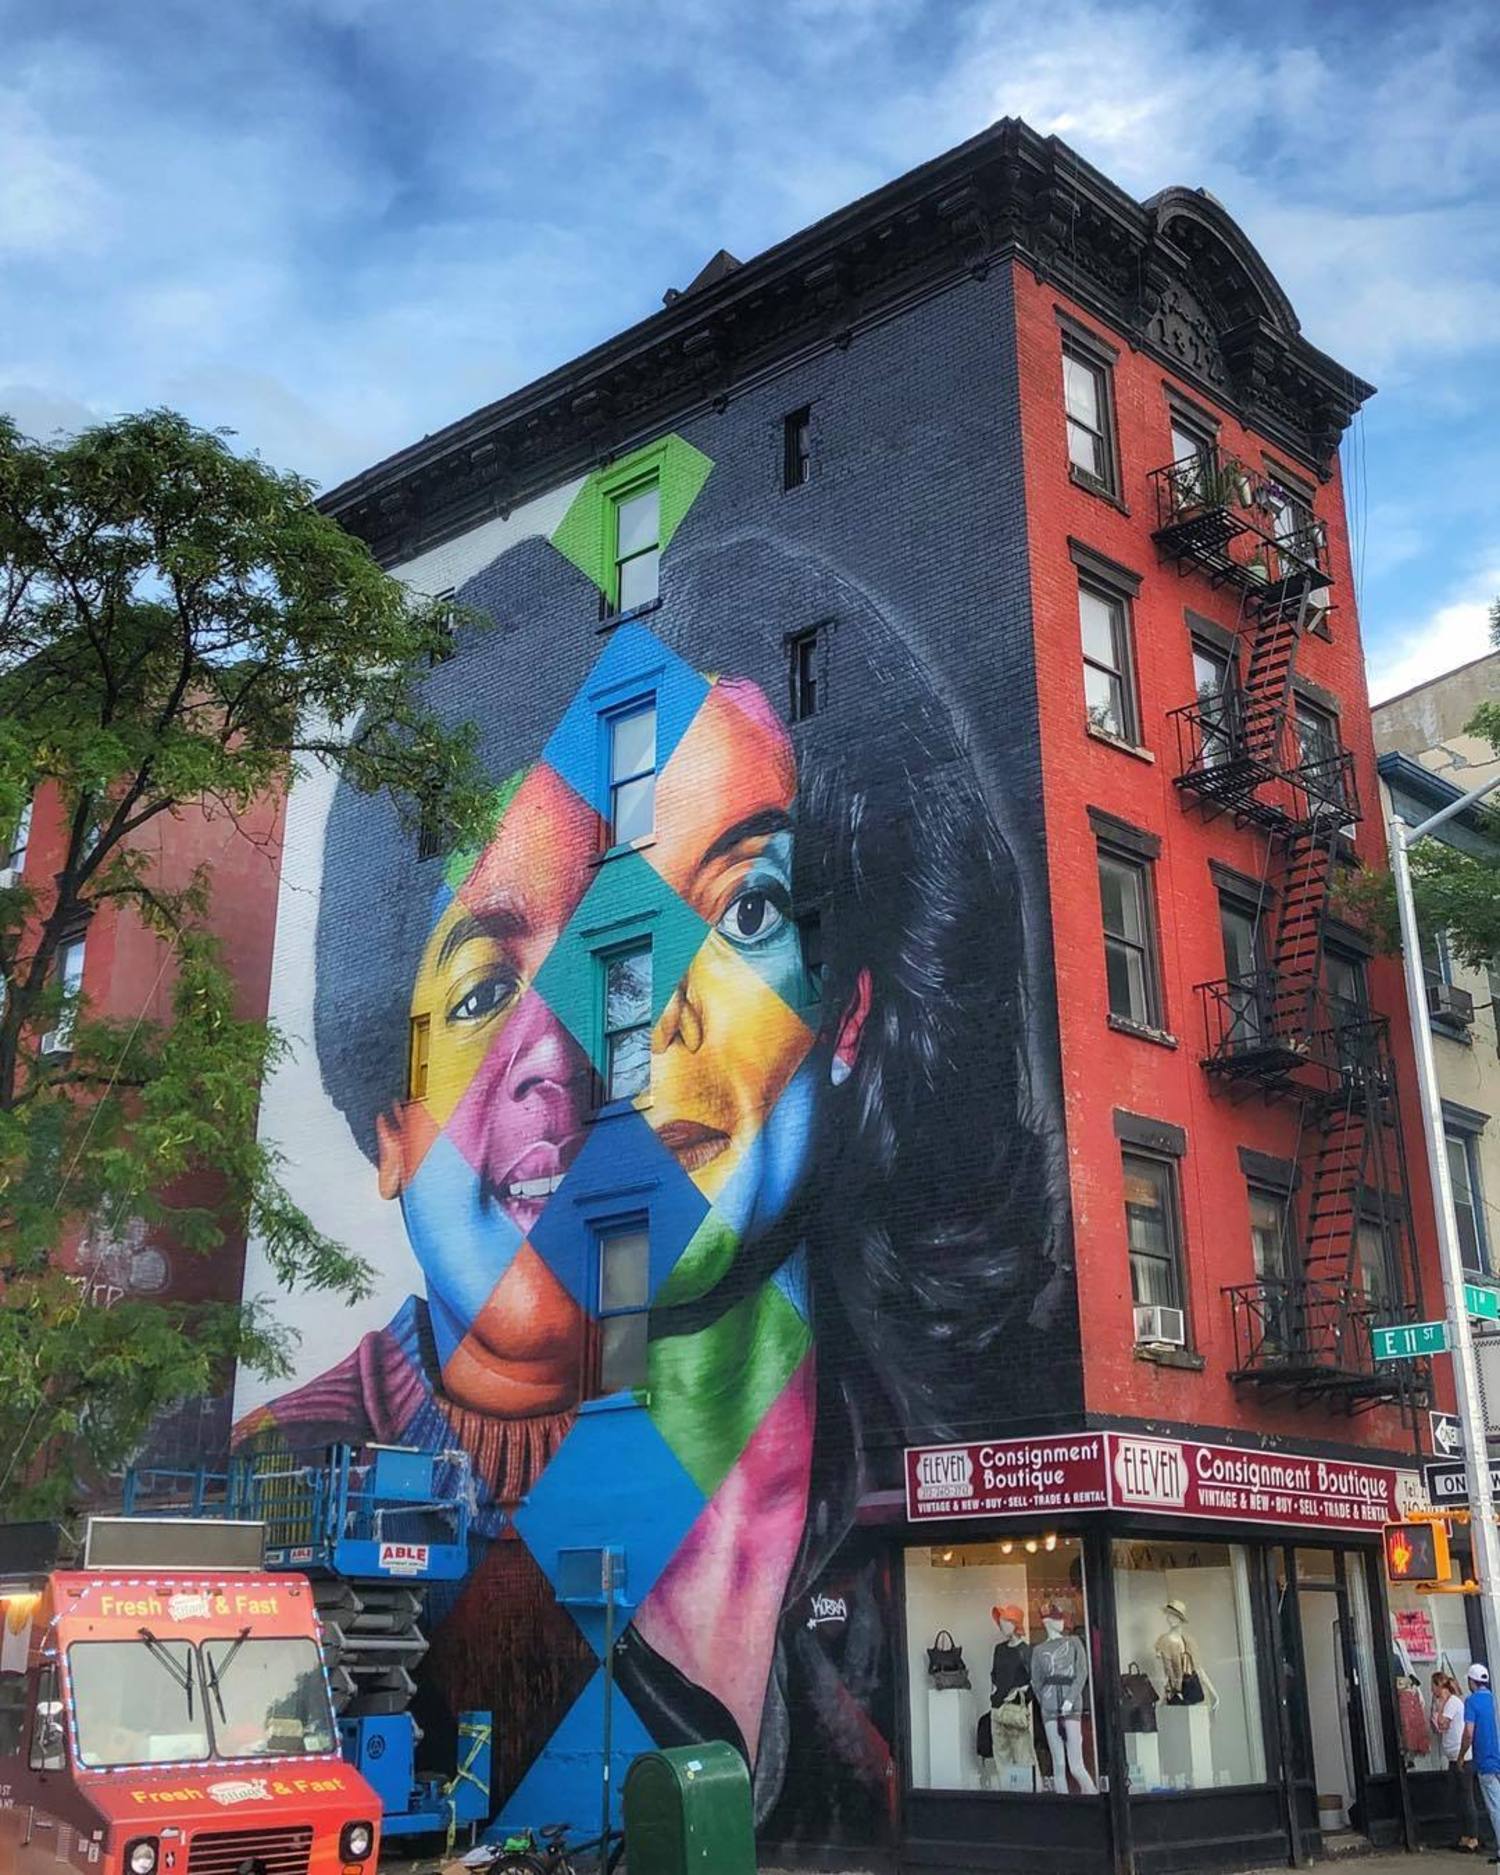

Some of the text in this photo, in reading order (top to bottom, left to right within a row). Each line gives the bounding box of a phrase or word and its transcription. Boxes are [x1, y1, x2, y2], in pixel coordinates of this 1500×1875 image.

[1385, 1327, 1434, 1354] E 11 ST
[979, 1440, 1099, 1469] Consignment
[923, 1455, 965, 1484] ELEVEN
[984, 1469, 1065, 1492] Boutique
[1123, 1446, 1180, 1499] ELEVEN
[1196, 1448, 1388, 1504] Consignment Boutique
[1444, 1475, 1467, 1492] ON
[917, 1490, 1106, 1514] VINTAGE & NEW BUY SELL TRADE & RENTAL
[1198, 1488, 1237, 1508] VINTAGE
[1240, 1491, 1247, 1510] &
[1249, 1492, 1269, 1511] NEW
[1275, 1495, 1293, 1513] BUY
[1299, 1498, 1319, 1516] SELL
[1323, 1501, 1350, 1519] TRADE
[1353, 1503, 1360, 1520] &
[1361, 1505, 1388, 1521] RENTAL
[382, 1546, 426, 1562] ABLE
[101, 1595, 162, 1616] Fresh
[215, 1595, 230, 1615] &
[235, 1596, 279, 1615] Fast
[131, 1786, 204, 1804] Fresh
[272, 1781, 292, 1795] &
[292, 1778, 346, 1793] Fast
